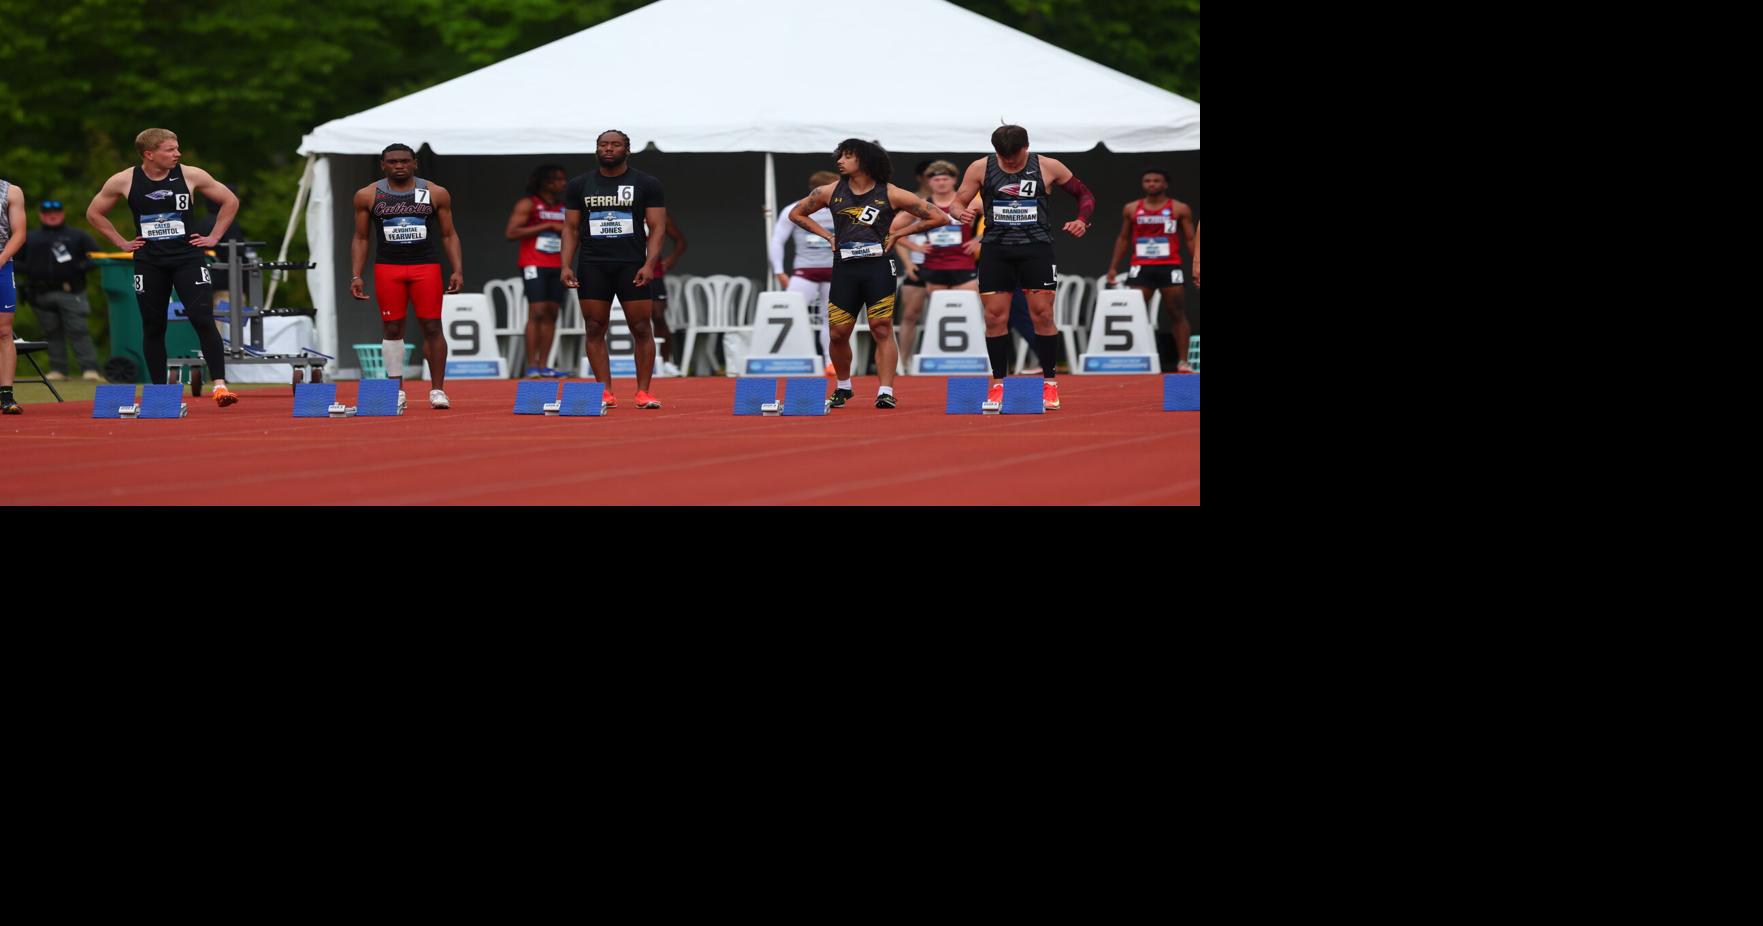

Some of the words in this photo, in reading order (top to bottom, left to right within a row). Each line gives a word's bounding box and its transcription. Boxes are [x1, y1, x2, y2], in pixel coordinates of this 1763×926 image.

[418, 189, 427, 203] 7
[622, 186, 631, 200] 6
[1021, 181, 1033, 196] 4
[179, 194, 187, 209] 8
[861, 207, 876, 222] 5
[994, 213, 1037, 221] ZIMMERMAN
[135, 275, 141, 290] 8
[449, 320, 480, 356] 9
[767, 317, 794, 354] 7
[938, 316, 969, 352] 6
[1104, 315, 1134, 351] 5
